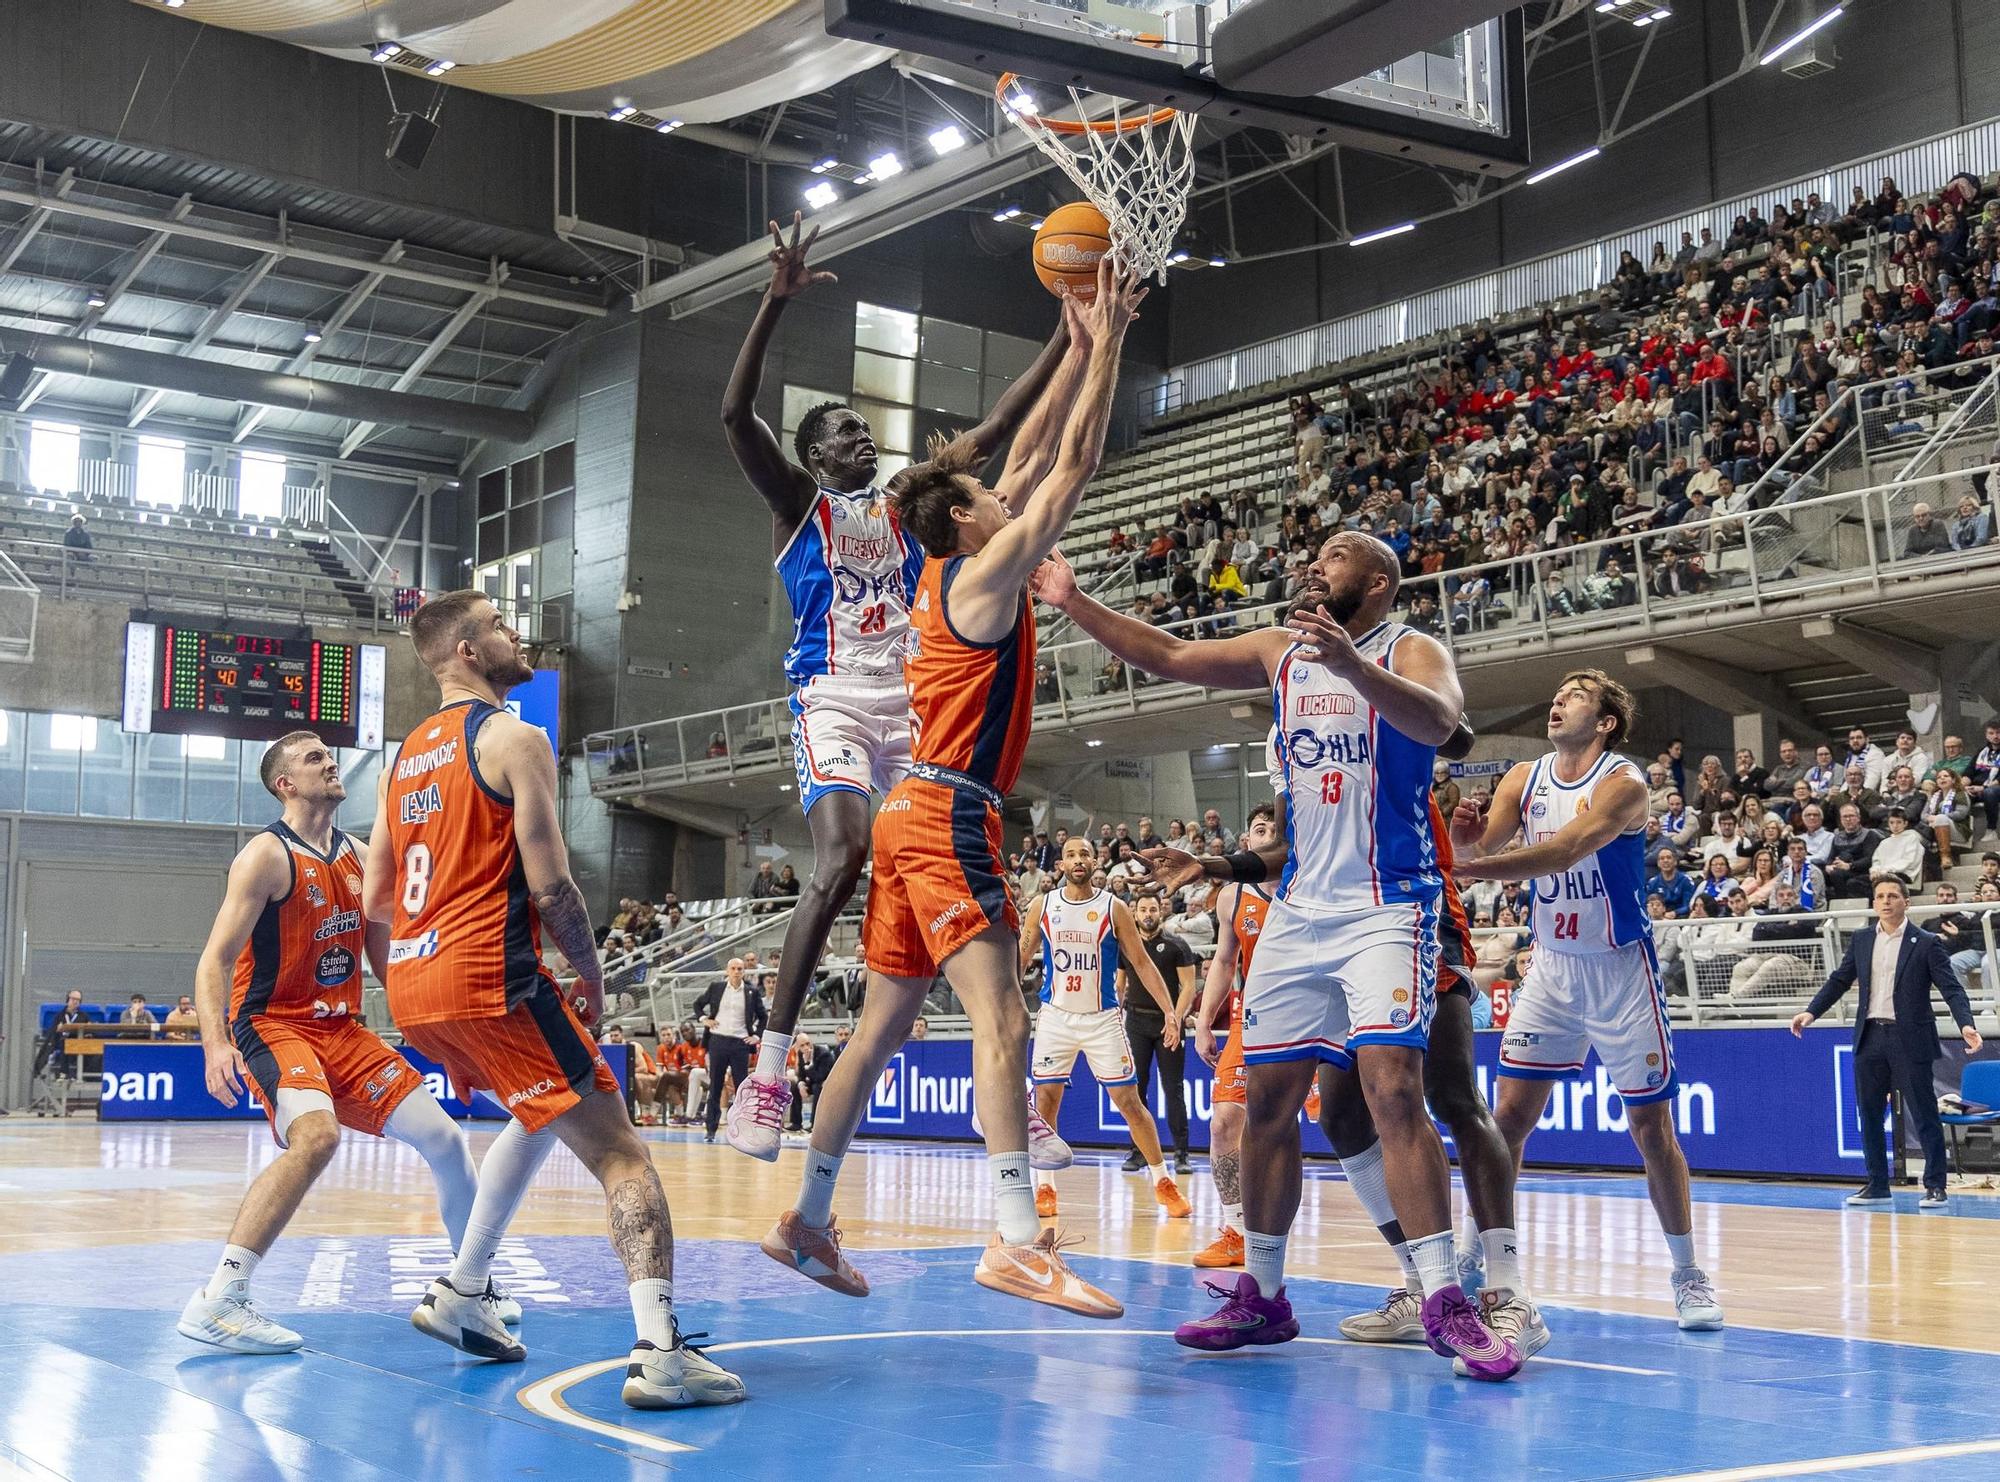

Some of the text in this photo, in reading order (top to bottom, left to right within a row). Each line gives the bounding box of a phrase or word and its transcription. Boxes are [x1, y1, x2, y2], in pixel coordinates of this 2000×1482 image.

[860, 603, 886, 635] 23
[211, 655, 239, 665] LOCAL
[217, 670, 238, 686] 40
[284, 675, 304, 692] 45
[1296, 693, 1355, 717] LUCENTUM
[1327, 733, 1371, 764] HLA
[818, 756, 850, 770] suma
[1465, 763, 1500, 774] ALICANTE
[1320, 771, 1343, 805] 13
[402, 840, 433, 920] 8
[1565, 869, 1606, 900] HLA
[1554, 912, 1579, 940] 24
[321, 955, 349, 967] Estrella
[1074, 953, 1098, 970] HLA
[321, 965, 346, 977] Galicia
[1066, 975, 1082, 992] 33
[1503, 1037, 1528, 1047] suma
[910, 1065, 974, 1114] Inur
